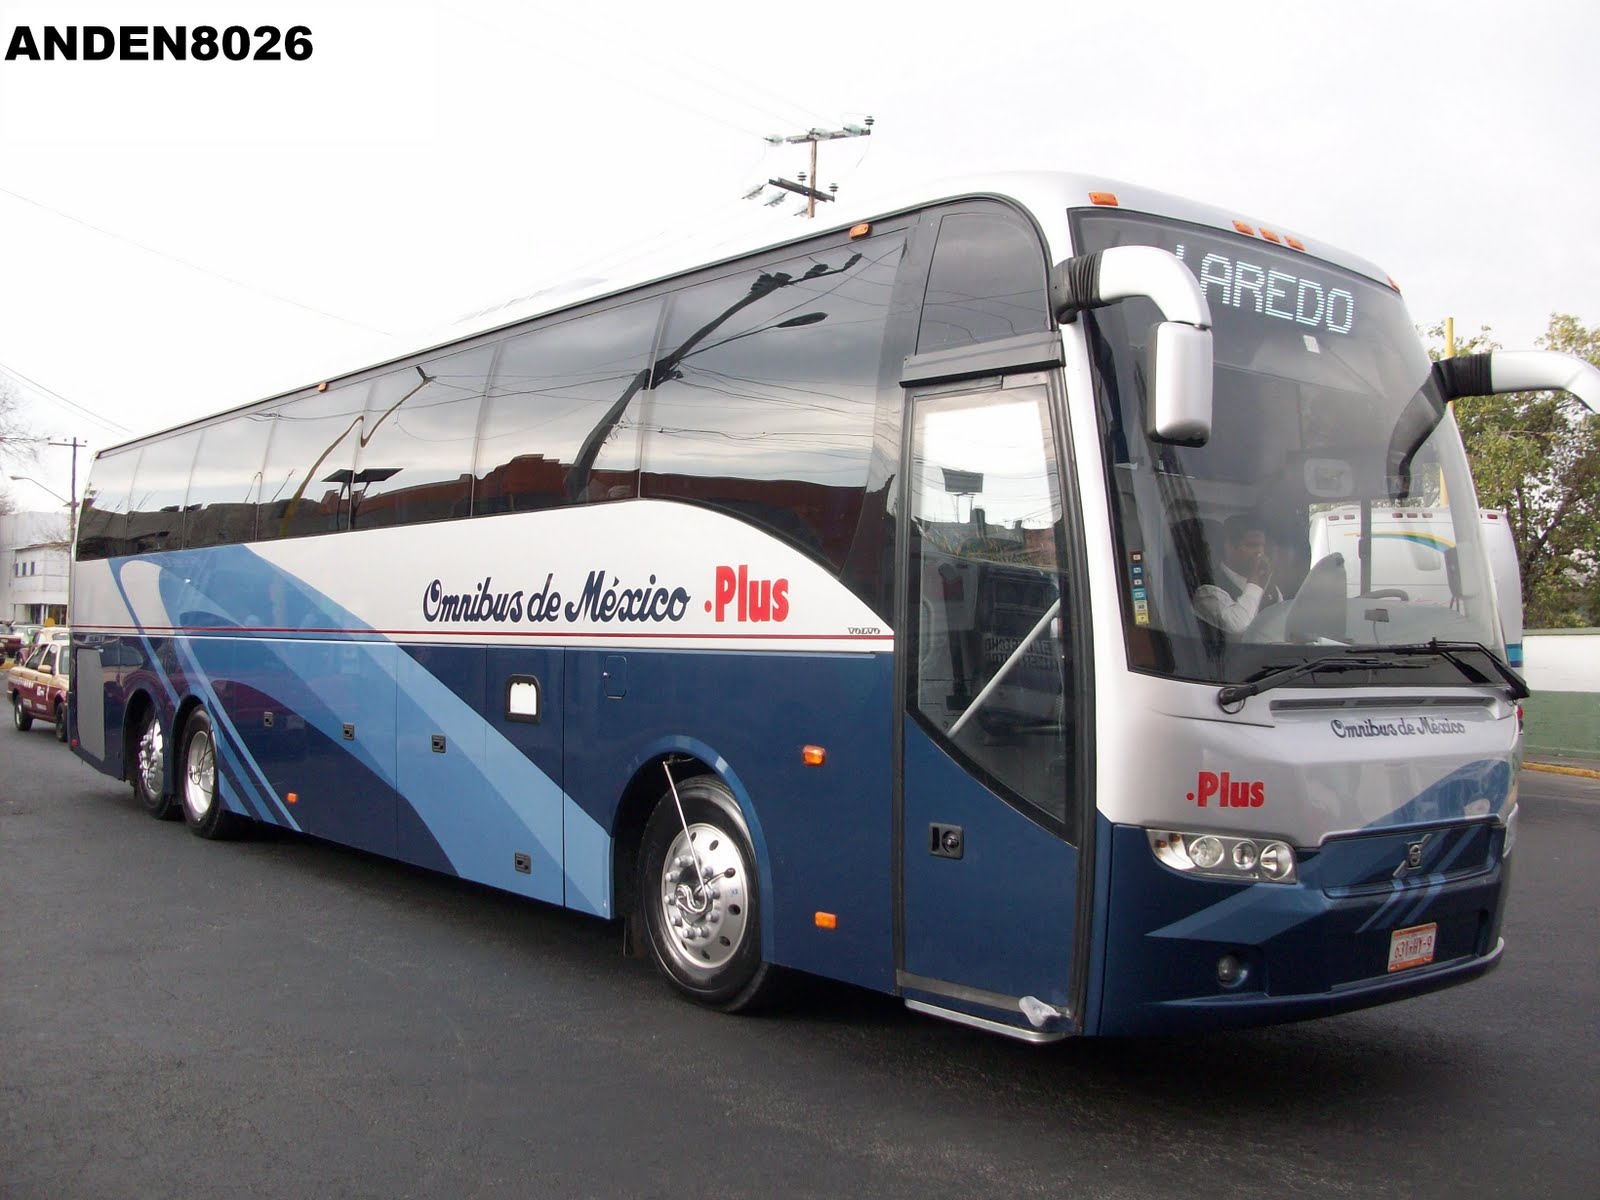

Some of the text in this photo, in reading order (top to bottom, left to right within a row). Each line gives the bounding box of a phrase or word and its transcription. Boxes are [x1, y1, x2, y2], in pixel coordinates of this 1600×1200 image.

[1175, 244, 1355, 335] AREDO
[422, 576, 524, 623] Omnibus
[526, 572, 562, 623] de
[564, 570, 692, 623] México
[847, 626, 881, 635] VOLVO
[1330, 718, 1397, 739] Omnibus
[1397, 717, 1415, 736] de
